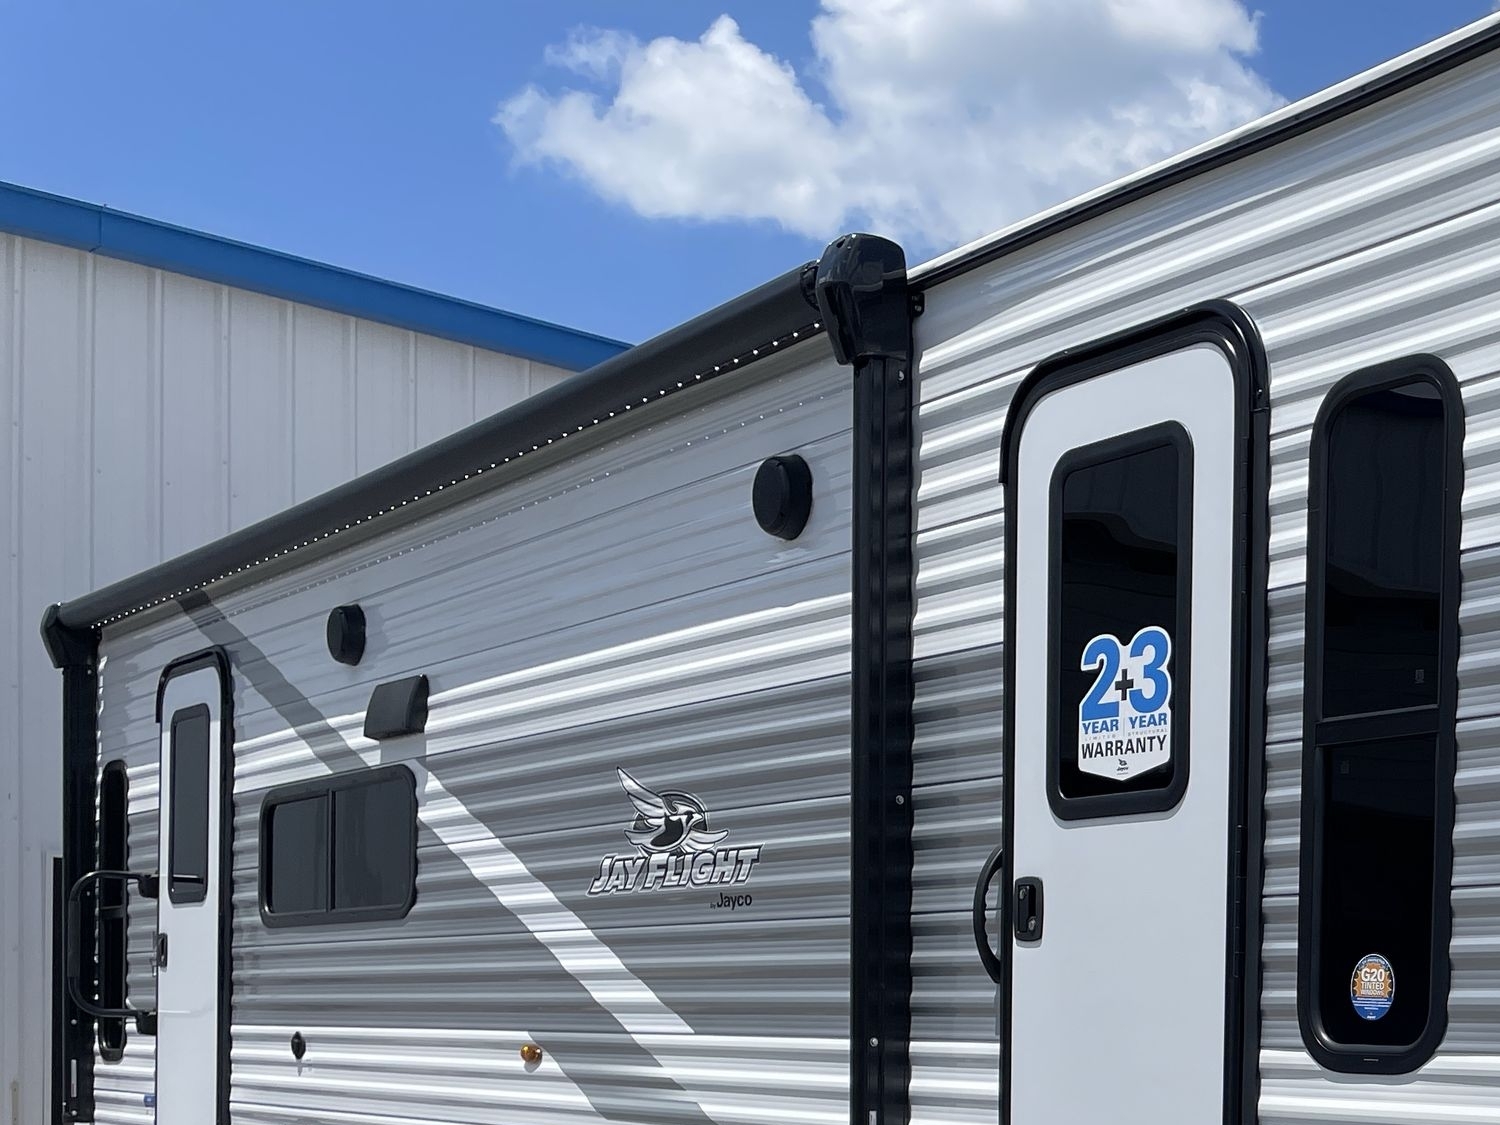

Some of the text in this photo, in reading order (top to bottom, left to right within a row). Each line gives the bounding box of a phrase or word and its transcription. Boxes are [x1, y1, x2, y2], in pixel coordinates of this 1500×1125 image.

[1082, 713, 1167, 735] YEAR YEAR
[1127, 728, 1168, 737] STRUCTURAL
[1081, 735, 1167, 759] WARRANTY
[586, 843, 765, 897] JAY FLIGHT
[716, 892, 753, 911] Jayco
[1361, 968, 1385, 982] G20
[1360, 981, 1385, 990] TINTED
